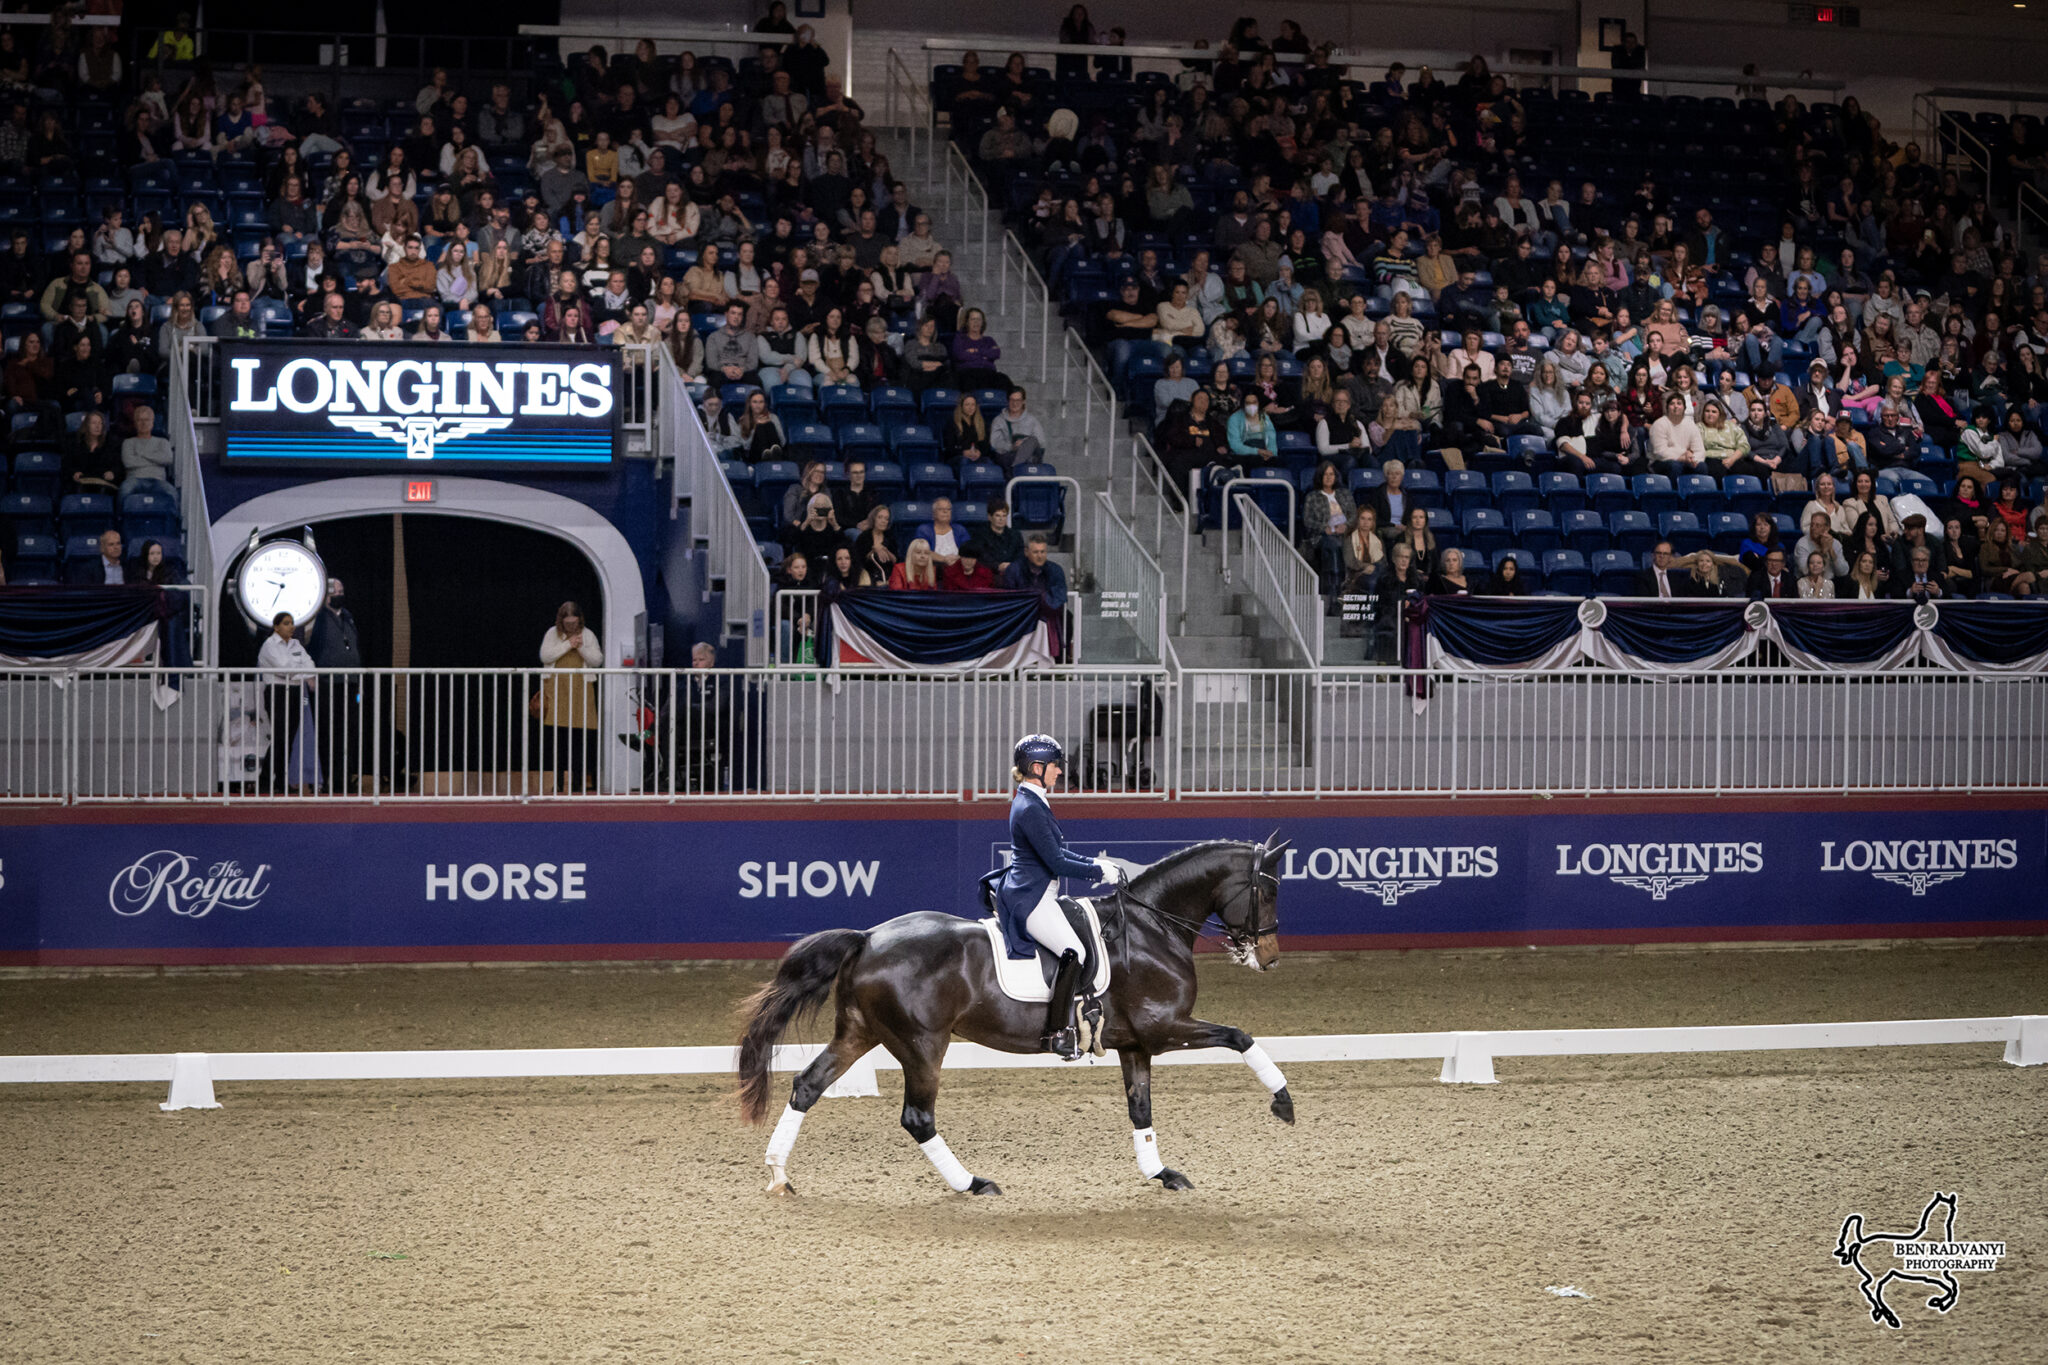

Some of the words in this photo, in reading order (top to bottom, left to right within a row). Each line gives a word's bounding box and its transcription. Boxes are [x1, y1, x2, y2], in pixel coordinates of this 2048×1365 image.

[230, 358, 613, 418] LONGINES
[408, 481, 432, 500] EXIT
[1101, 610, 1119, 618] SEATS
[208, 860, 244, 878] The
[1282, 846, 1498, 880] LONGINES
[1556, 842, 1763, 875] LONGINES
[1821, 839, 2018, 871] LONGINES
[109, 850, 270, 918] Royal
[425, 863, 587, 901] HORSE
[738, 860, 880, 898] SHOW
